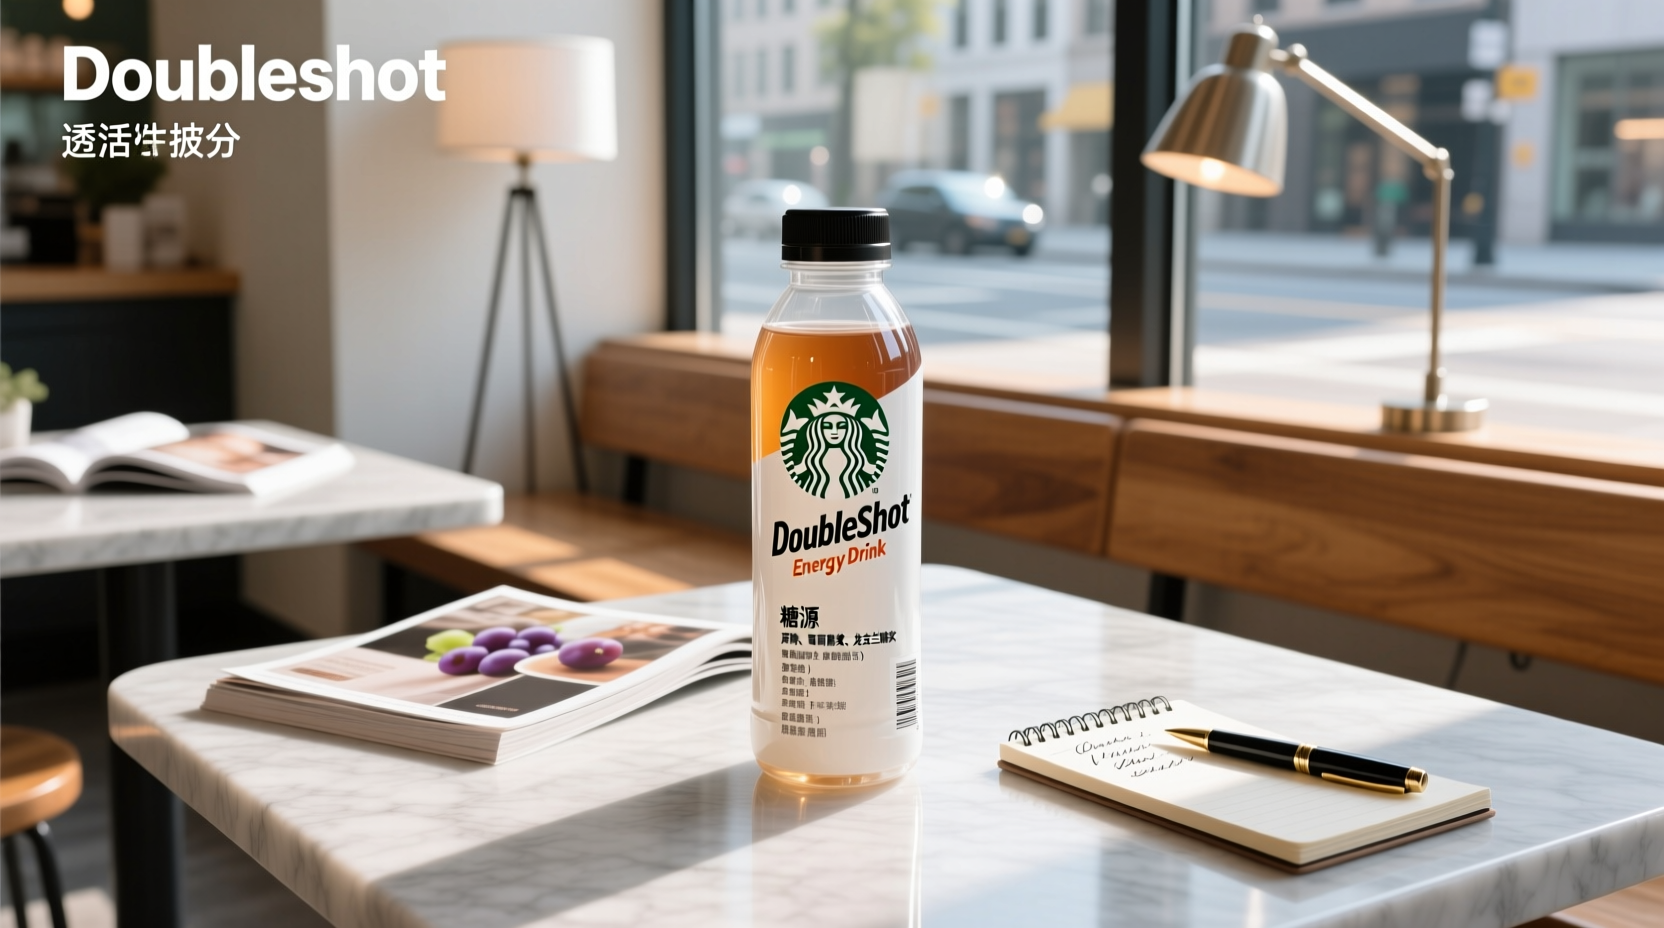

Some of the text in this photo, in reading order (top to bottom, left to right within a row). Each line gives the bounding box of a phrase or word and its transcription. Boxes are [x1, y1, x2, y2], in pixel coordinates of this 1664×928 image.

[772, 494, 910, 557] DoubleShot
[792, 539, 886, 577] Energy Drink
[780, 605, 820, 629] 糖源
